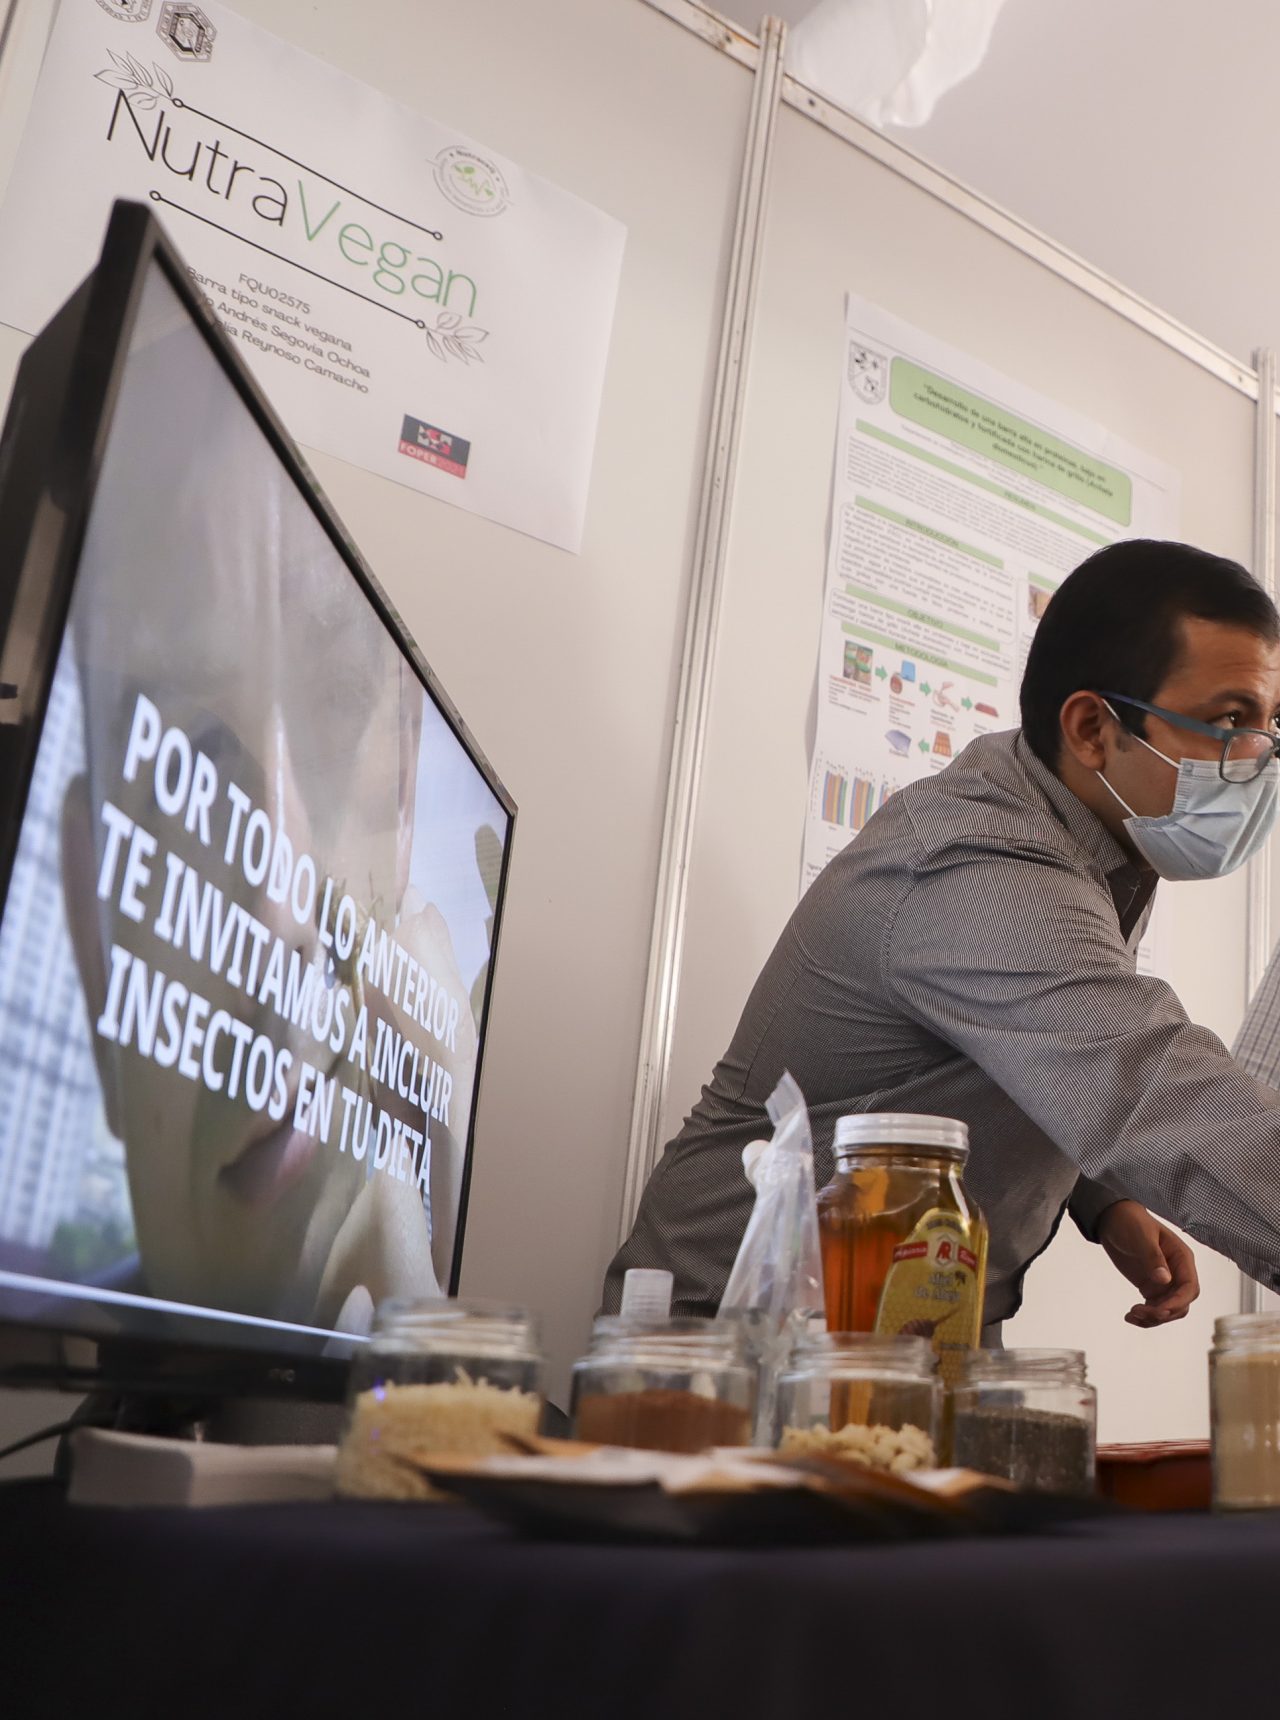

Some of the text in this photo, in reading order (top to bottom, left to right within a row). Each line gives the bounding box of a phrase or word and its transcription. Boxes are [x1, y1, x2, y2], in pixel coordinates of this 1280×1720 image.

[231, 288, 259, 309] tipo
[262, 305, 302, 329] snack
[304, 321, 353, 353] vegana
[238, 272, 312, 316] FQU02575
[217, 301, 371, 379] Andrés Segovia Ochoa
[241, 329, 302, 365] Reynoso
[304, 358, 370, 395] Camacho
[122, 692, 460, 1053] POR TODO LO ANTERIOR
[97, 800, 454, 1128] TE INVITAMOS A INCLUIR
[97, 944, 432, 1193] INSECTOS EN TU DIETA
